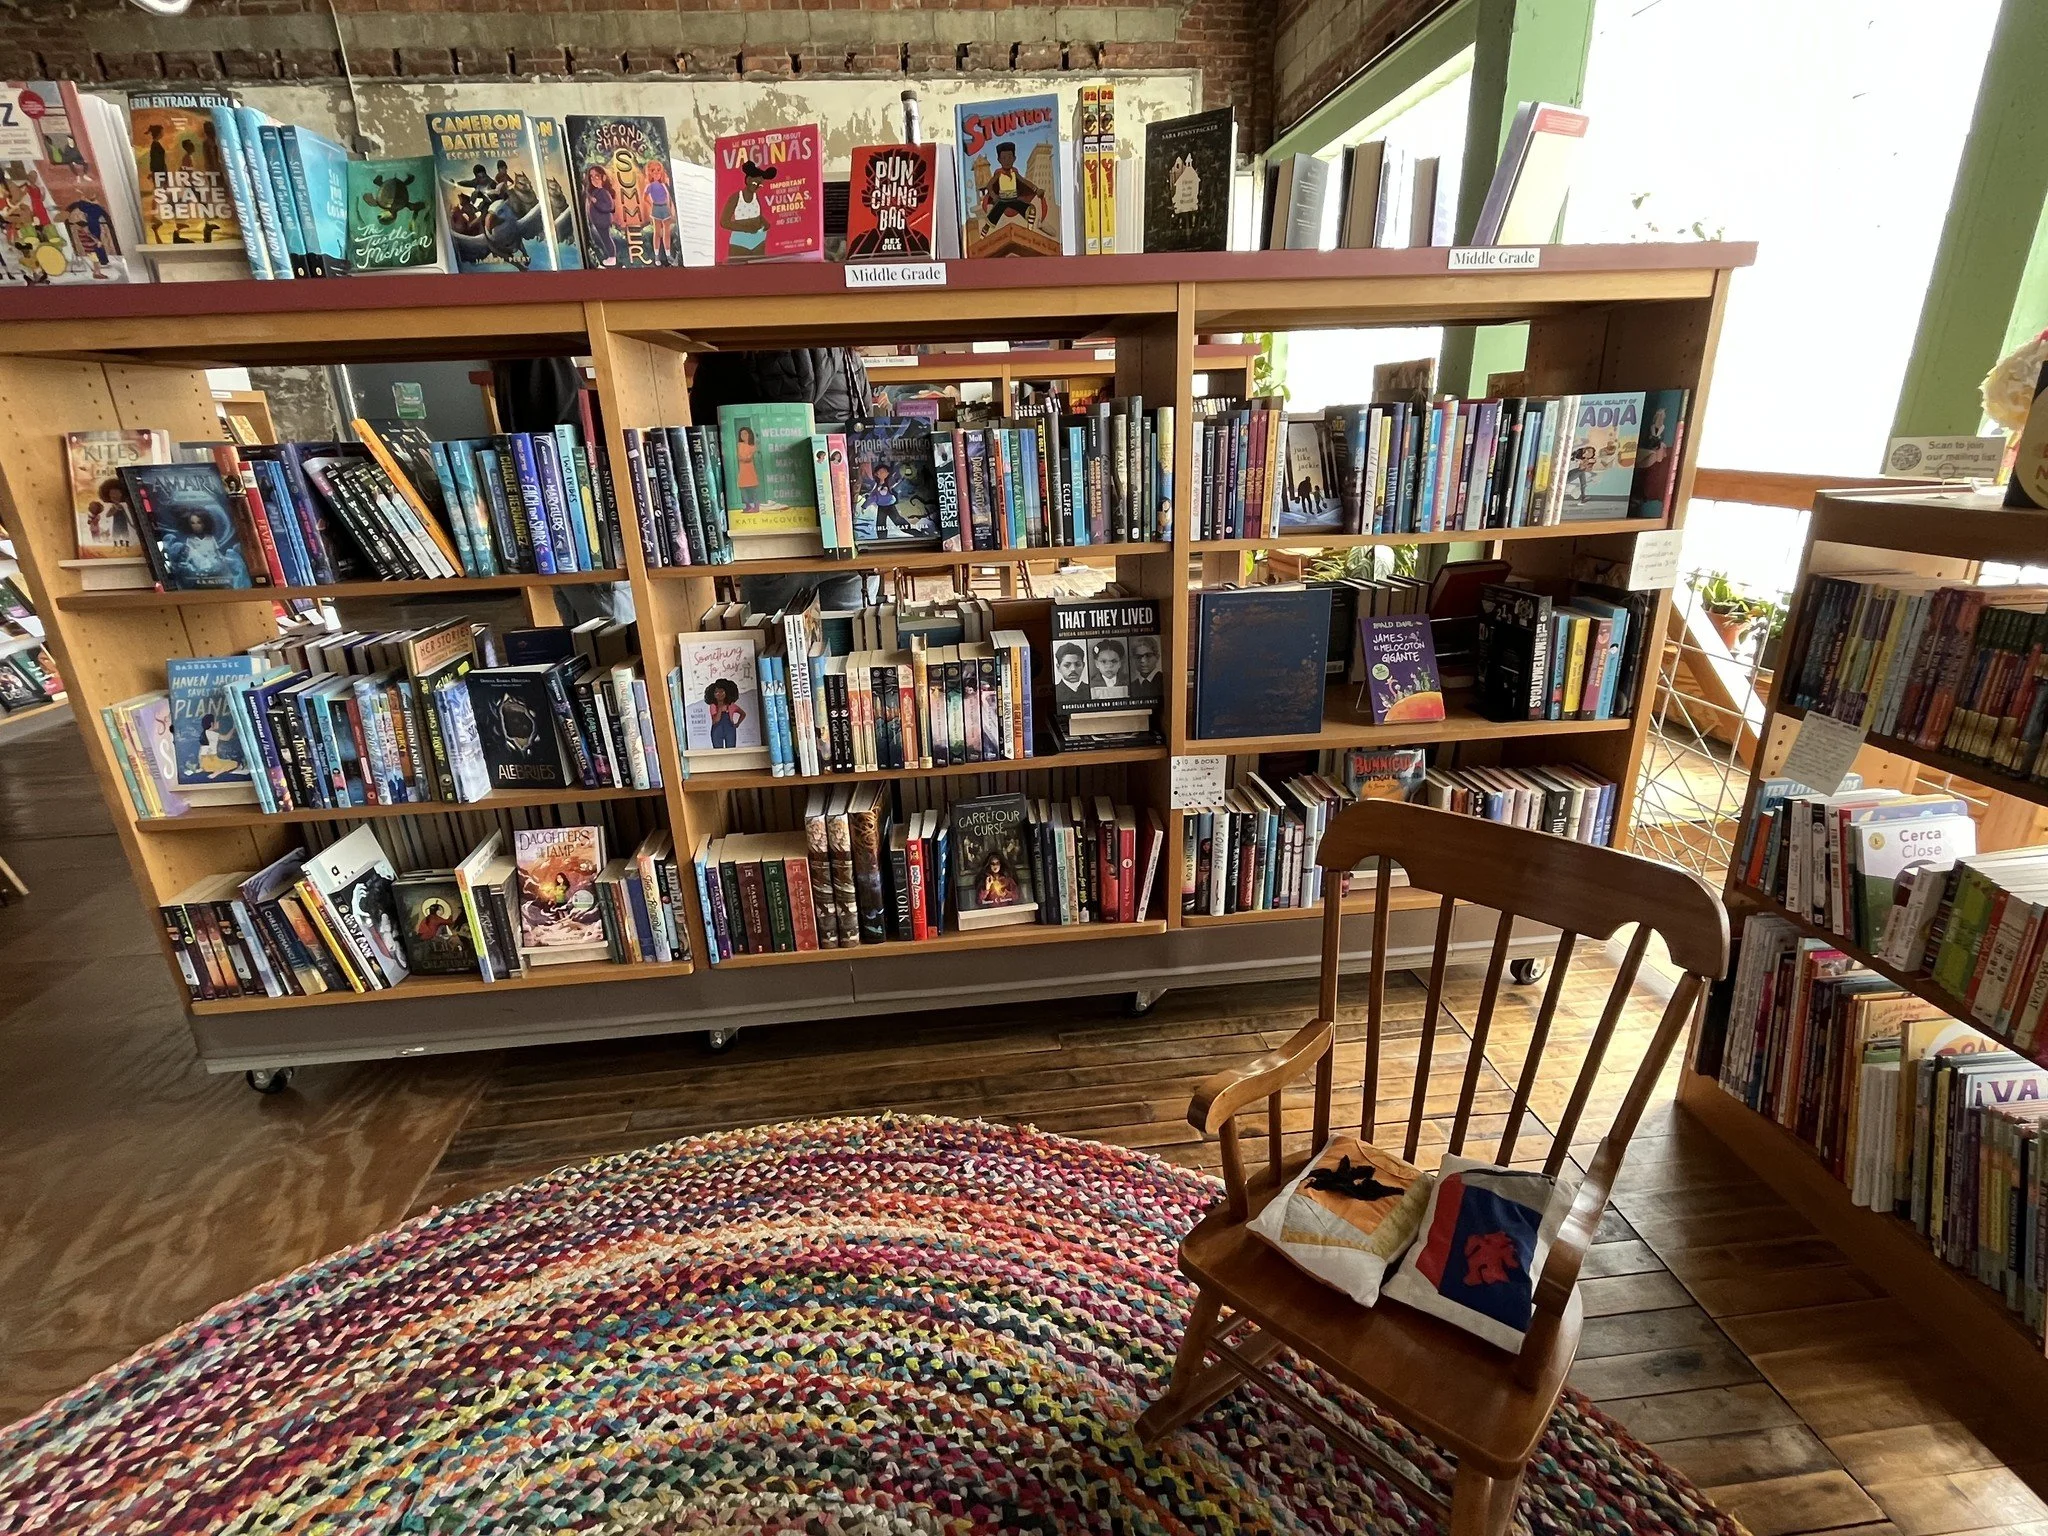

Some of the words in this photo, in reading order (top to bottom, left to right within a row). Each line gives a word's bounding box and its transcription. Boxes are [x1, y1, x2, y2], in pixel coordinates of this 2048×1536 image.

[153, 96, 197, 107] ENTRADA
[200, 97, 228, 107] KELLY
[432, 114, 522, 133] CAMERON
[596, 124, 646, 141] SECOND
[1162, 130, 1176, 139] SARA
[1177, 124, 1218, 138] PENNYPACKER
[441, 133, 499, 150] BATTLE
[596, 136, 647, 154] CHANCE
[741, 139, 756, 147] NEED
[782, 131, 801, 141] ABOUT
[446, 151, 481, 160] ESCAPE
[484, 150, 519, 158] TRIALS
[723, 138, 812, 169] VAGINAS
[154, 172, 220, 187] FIRST
[876, 156, 914, 188] PUN
[770, 178, 806, 189] IMPORTANT
[154, 188, 226, 204] STATE
[765, 191, 812, 206] VULVAS,
[871, 183, 918, 209] CHING
[159, 203, 232, 219] BEING
[615, 150, 652, 264] SUMMER
[771, 201, 806, 213] PERIODS,
[880, 208, 905, 231] BAG
[358, 224, 384, 236] The
[355, 226, 416, 256] Turtle
[357, 235, 433, 268] Michigan
[1453, 251, 1496, 266] Middle
[1498, 251, 1535, 265] Grade
[851, 268, 898, 283] Middle
[901, 267, 941, 281] Grade
[761, 428, 803, 438] WELCOME
[83, 444, 140, 462] KITES
[693, 438, 702, 453] THE
[855, 440, 883, 452] PAOLA
[887, 437, 931, 451] SANTIAGO
[1928, 441, 1952, 450] Scan
[1955, 441, 1965, 449] to
[1967, 441, 1984, 450] join
[562, 455, 572, 476] TWO
[1297, 462, 1320, 472] jackie
[1946, 453, 1979, 462] mailing
[1981, 453, 1997, 461] list.
[501, 454, 518, 493] CHARLIE
[589, 464, 598, 476] THE
[566, 476, 577, 504] TRIBES
[592, 476, 601, 502] RAINBOW
[937, 473, 946, 492] LOST
[1275, 470, 1283, 496] MERCY
[1385, 466, 1398, 507] EVERDARK
[523, 482, 539, 507] EACH
[701, 487, 710, 499] OF
[773, 490, 801, 499] COHEN
[944, 472, 958, 518] KEEPER
[1062, 483, 1072, 517] ECLIPSE
[1075, 491, 1082, 502] AT
[545, 482, 564, 532] MARVELLERS
[596, 501, 604, 522] BRIDGE
[703, 498, 713, 523] STONE
[939, 493, 948, 524] CITIES
[333, 477, 349, 499] THE
[348, 501, 369, 528] WILD
[368, 530, 392, 560] ROBOT
[257, 518, 273, 551] FEVER
[530, 518, 548, 548] SPARK
[707, 523, 717, 550] CREEK
[1057, 610, 1087, 630] THAT
[1089, 609, 1118, 628] THEY
[1121, 607, 1153, 626] LIVED
[1373, 621, 1393, 629] ROALD
[420, 641, 435, 656] HER
[437, 627, 470, 648] STORIES
[694, 646, 743, 665] Something
[1381, 652, 1420, 663] GIGANTE
[709, 664, 718, 677] To
[723, 662, 741, 673] Say
[791, 663, 800, 699] PLAYLIST
[799, 662, 810, 698] PLAYLIST
[188, 688, 210, 698] SAVES
[287, 705, 297, 728] ELLE
[1002, 701, 1014, 722] BARREN
[1013, 703, 1021, 711] THE
[320, 715, 331, 734] MISS
[375, 719, 385, 735] ONE
[611, 720, 621, 733] The
[1013, 711, 1022, 726] GREAT
[403, 709, 418, 748] HOUDINI
[295, 737, 308, 761] TASTE
[383, 717, 394, 733] ONE
[392, 750, 402, 771] WORD
[395, 726, 407, 754] LEGACY
[614, 735, 627, 755] Night
[410, 747, 421, 763] AND
[413, 763, 424, 779] ME
[499, 764, 555, 780] ALEBRIJES
[618, 756, 631, 775] Diary
[301, 764, 316, 790] MAGIC
[1766, 785, 1787, 797] TEN
[958, 810, 1020, 828] CARREFOUR
[973, 823, 1005, 836] CURSE
[1900, 829, 1941, 842] Cerca
[519, 830, 591, 851] DAUGHTERS
[546, 844, 575, 858] LAMP
[1213, 831, 1226, 871] COURAGE
[1902, 844, 1942, 859] Close
[641, 874, 656, 893] THIS
[665, 868, 682, 909] LUPICA
[797, 880, 806, 905] HARRY
[713, 885, 721, 910] HARRY
[717, 910, 726, 936] POTTER
[750, 884, 758, 909] HARRY
[754, 909, 763, 934] POTTER
[773, 881, 782, 906] HARRY
[778, 907, 787, 932] POTTER
[895, 886, 909, 923] YORK
[647, 899, 662, 933] RAINBOW
[801, 906, 810, 931] POTTER
[263, 907, 298, 963] CHRESTOMANCI
[356, 936, 376, 961] BOOK
[2029, 960, 2048, 1009] BASQUIAT
